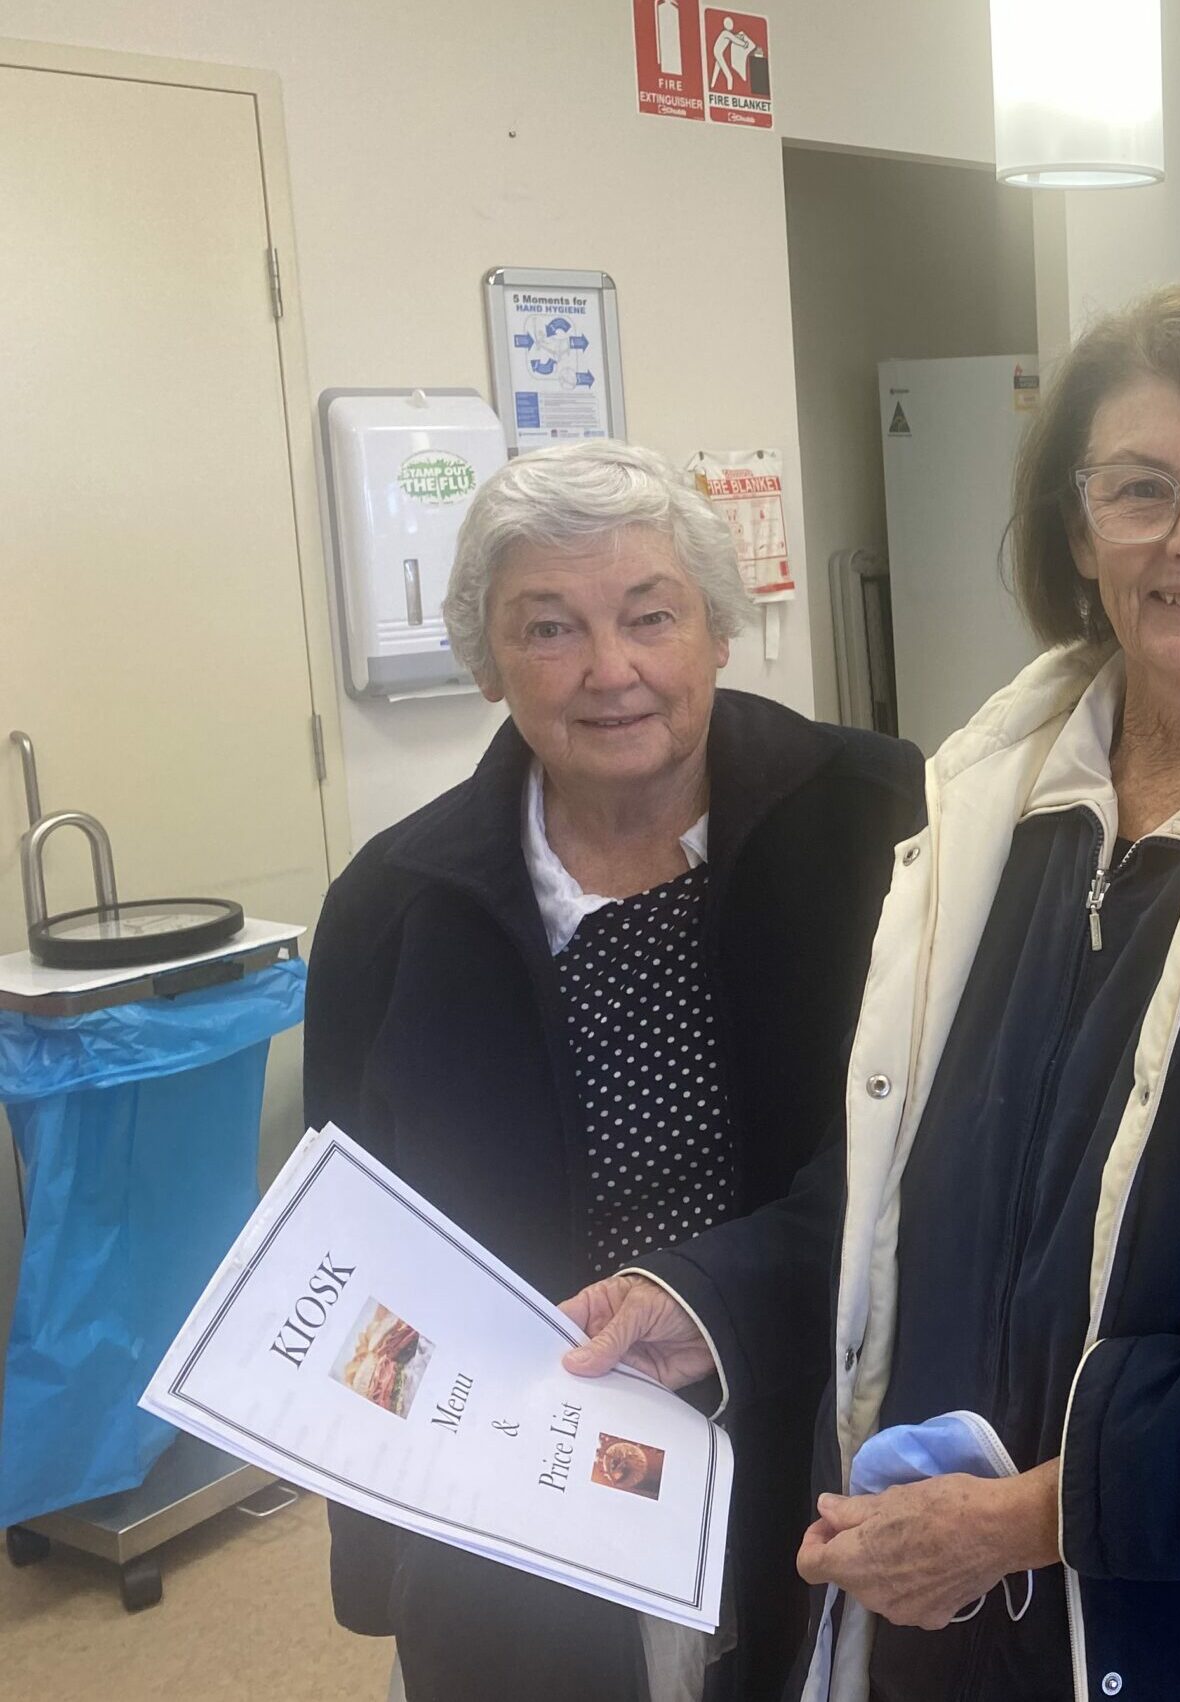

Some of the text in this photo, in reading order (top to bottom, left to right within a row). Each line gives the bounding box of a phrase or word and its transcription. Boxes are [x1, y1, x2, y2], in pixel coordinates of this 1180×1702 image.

[658, 78, 683, 91] FIRE
[640, 91, 703, 110] EXTINGUISHER
[709, 94, 771, 112] FIRE BLANKET
[513, 294, 587, 306] 5 Moments for
[516, 304, 586, 315] HAND HYGIENE
[444, 466, 467, 476] OUT
[401, 476, 470, 492] THE FLU
[730, 476, 779, 493] BLANKET
[269, 1251, 356, 1370] KIOSK
[431, 1372, 474, 1434] Menu
[491, 1420, 520, 1437] &
[538, 1401, 583, 1493] Price List
